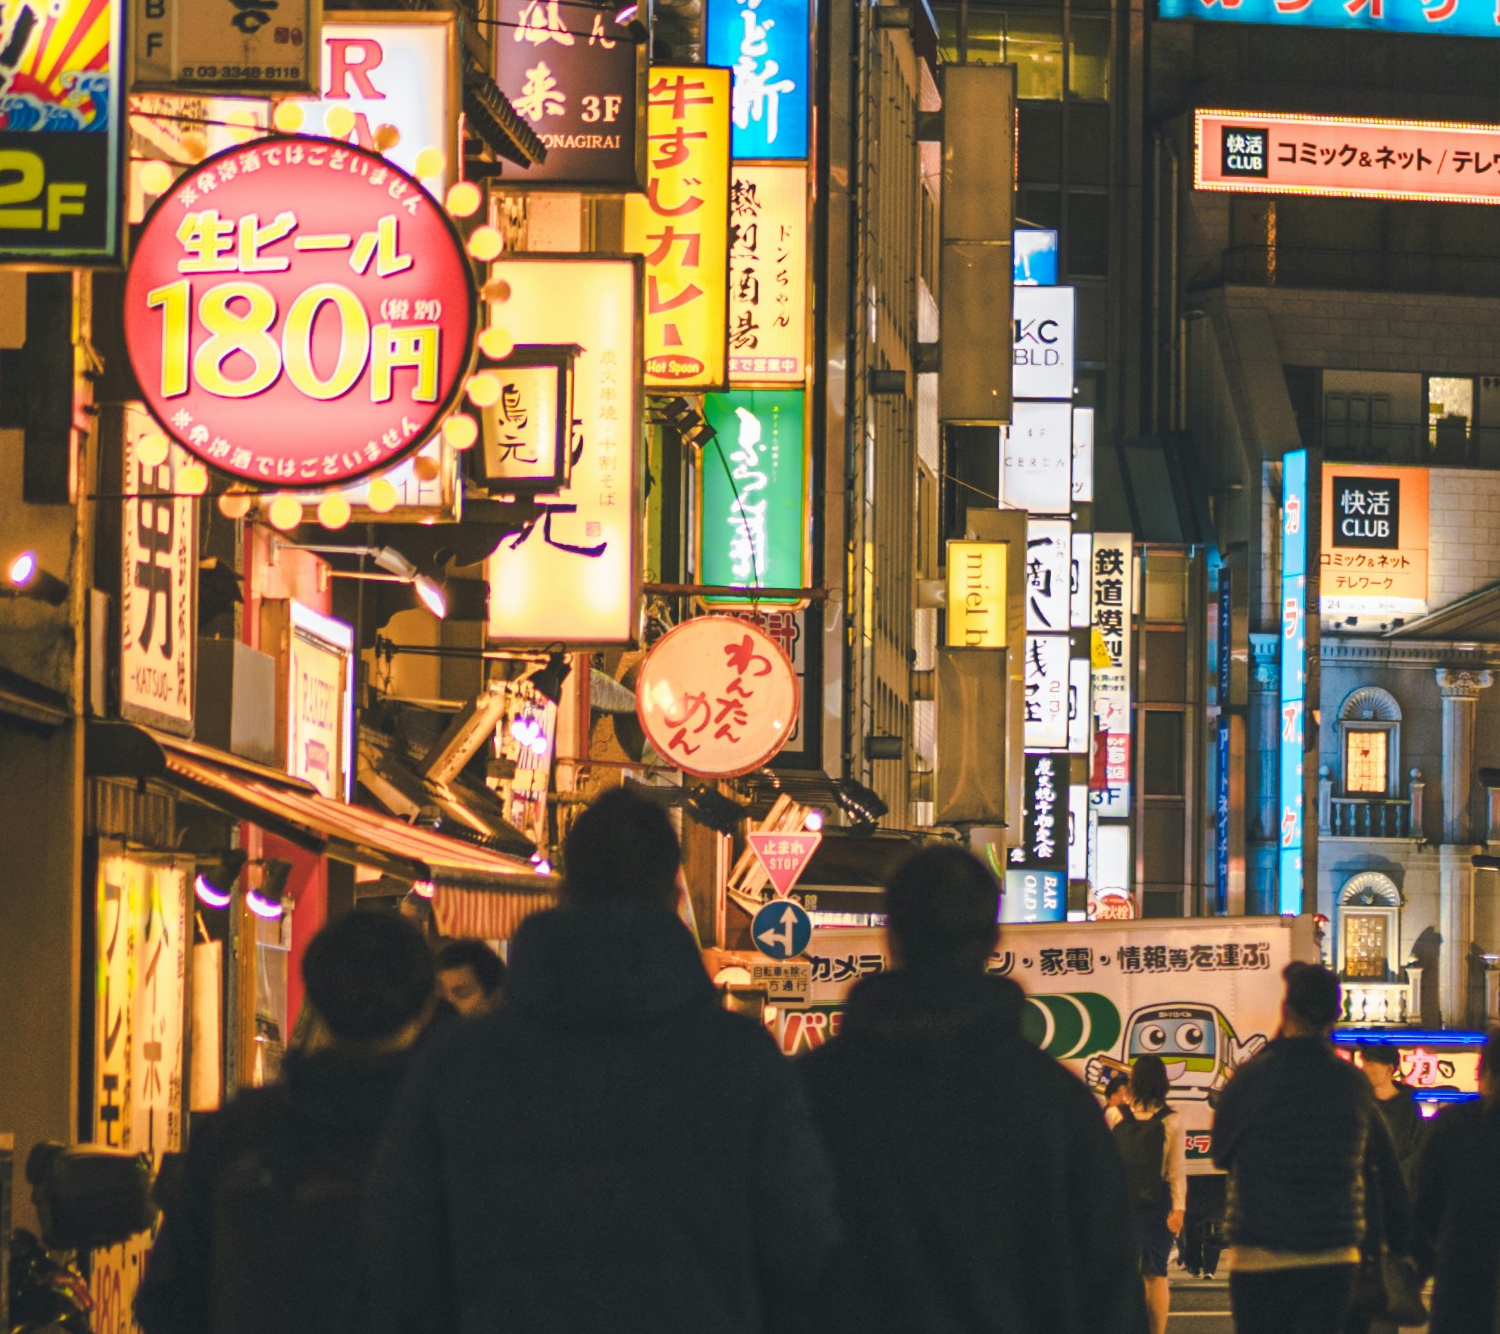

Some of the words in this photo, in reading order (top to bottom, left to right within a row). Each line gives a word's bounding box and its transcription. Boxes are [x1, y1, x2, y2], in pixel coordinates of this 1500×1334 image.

[580, 95, 623, 123] 3F
[1226, 134, 1263, 155] 快活
[1278, 141, 1433, 173] コミック&ネット
[1226, 153, 1263, 170] CLUB
[646, 73, 716, 348] 牛すじカレー
[175, 208, 413, 278] 生ビール
[773, 223, 792, 329] ドンちゃん
[146, 278, 441, 405] 180円
[647, 358, 667, 374] Hot
[668, 358, 701, 375] Spoon
[499, 383, 538, 464] 鳥元
[1340, 488, 1391, 516] 快活
[1341, 518, 1390, 538] CLUB
[1320, 553, 1411, 569] コミック&ネット
[965, 552, 988, 617] miel
[1335, 575, 1394, 589] テレワーク
[1281, 494, 1300, 848] カラオケ
[714, 634, 772, 744] わんたん
[664, 692, 711, 756] めん
[762, 839, 806, 856] 止まれ
[769, 857, 800, 871] STOP
[1043, 875, 1057, 909] BAR
[753, 965, 808, 979] 自転車を除く
[809, 952, 885, 983] カメラ
